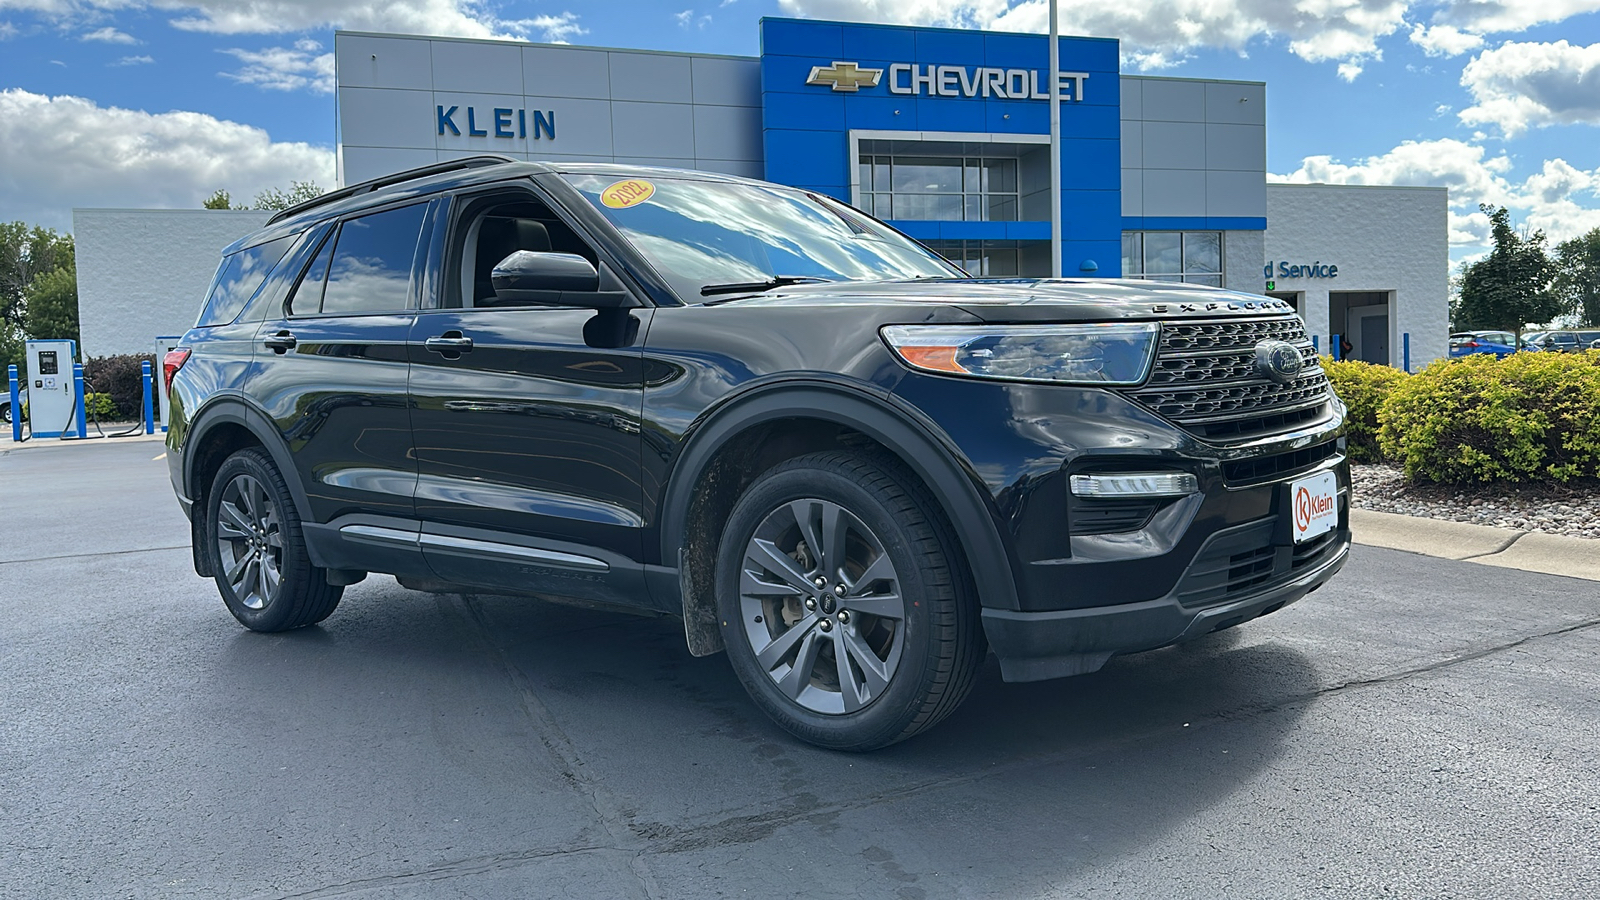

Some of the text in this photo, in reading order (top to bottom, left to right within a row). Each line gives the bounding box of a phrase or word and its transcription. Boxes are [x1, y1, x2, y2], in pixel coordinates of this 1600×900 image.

[889, 63, 1089, 101] CHEVROLET
[437, 105, 555, 140] KLEIN
[610, 181, 648, 205] 2022
[1280, 261, 1338, 278] Service
[1311, 493, 1333, 515] Klein
